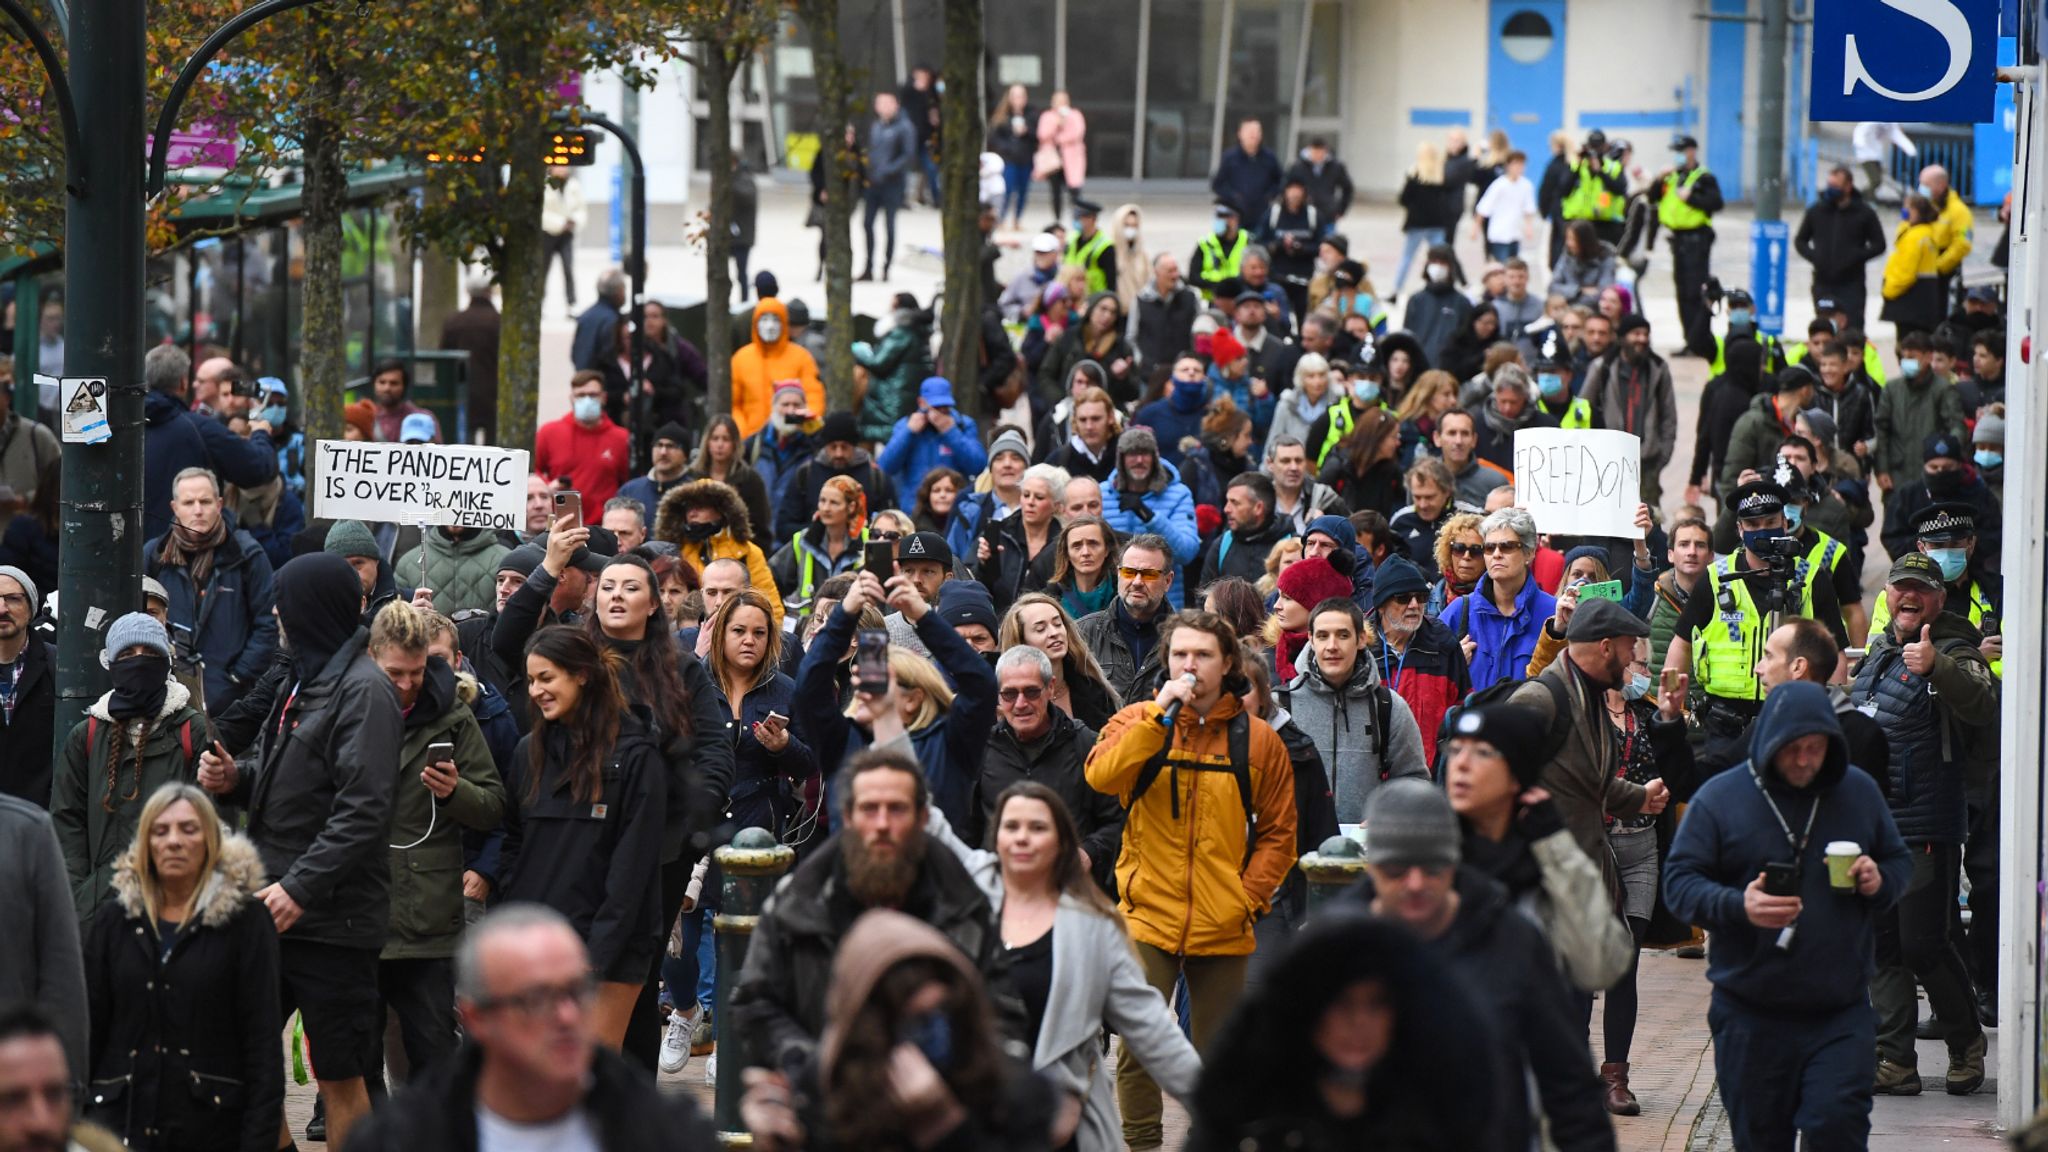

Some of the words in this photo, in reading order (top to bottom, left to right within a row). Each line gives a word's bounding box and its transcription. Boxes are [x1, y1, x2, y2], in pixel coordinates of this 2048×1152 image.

[387, 450, 512, 486] PANDEMIC
[1516, 445, 1639, 509] FREEDOM
[325, 476, 346, 499] IS
[424, 491, 446, 509] DR.
[447, 490, 493, 511] MIKE
[452, 509, 515, 529] YEADON
